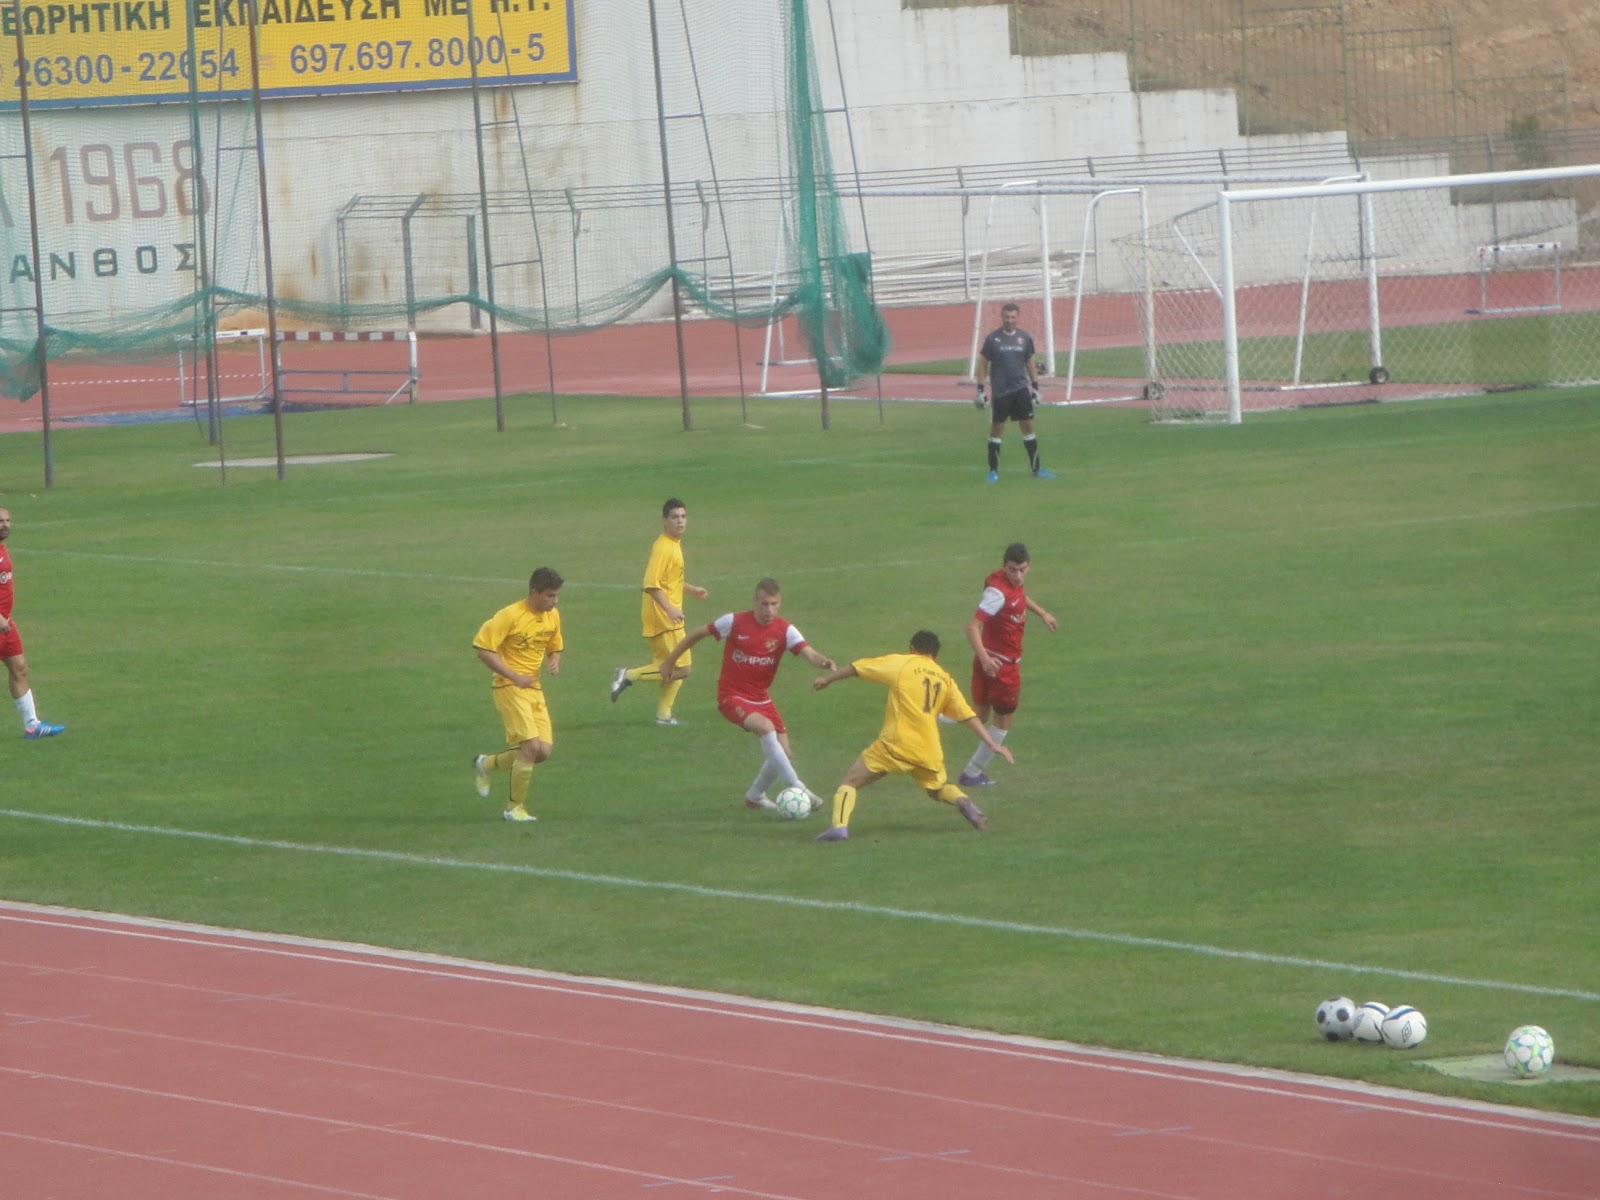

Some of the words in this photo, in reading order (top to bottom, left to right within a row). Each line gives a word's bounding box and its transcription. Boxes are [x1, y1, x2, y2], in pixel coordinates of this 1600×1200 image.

[194, 0, 401, 27] ΕΚΠΑΙΔΕΥΣΗ
[50, 138, 210, 224] 1968
[922, 677, 942, 714] 11
